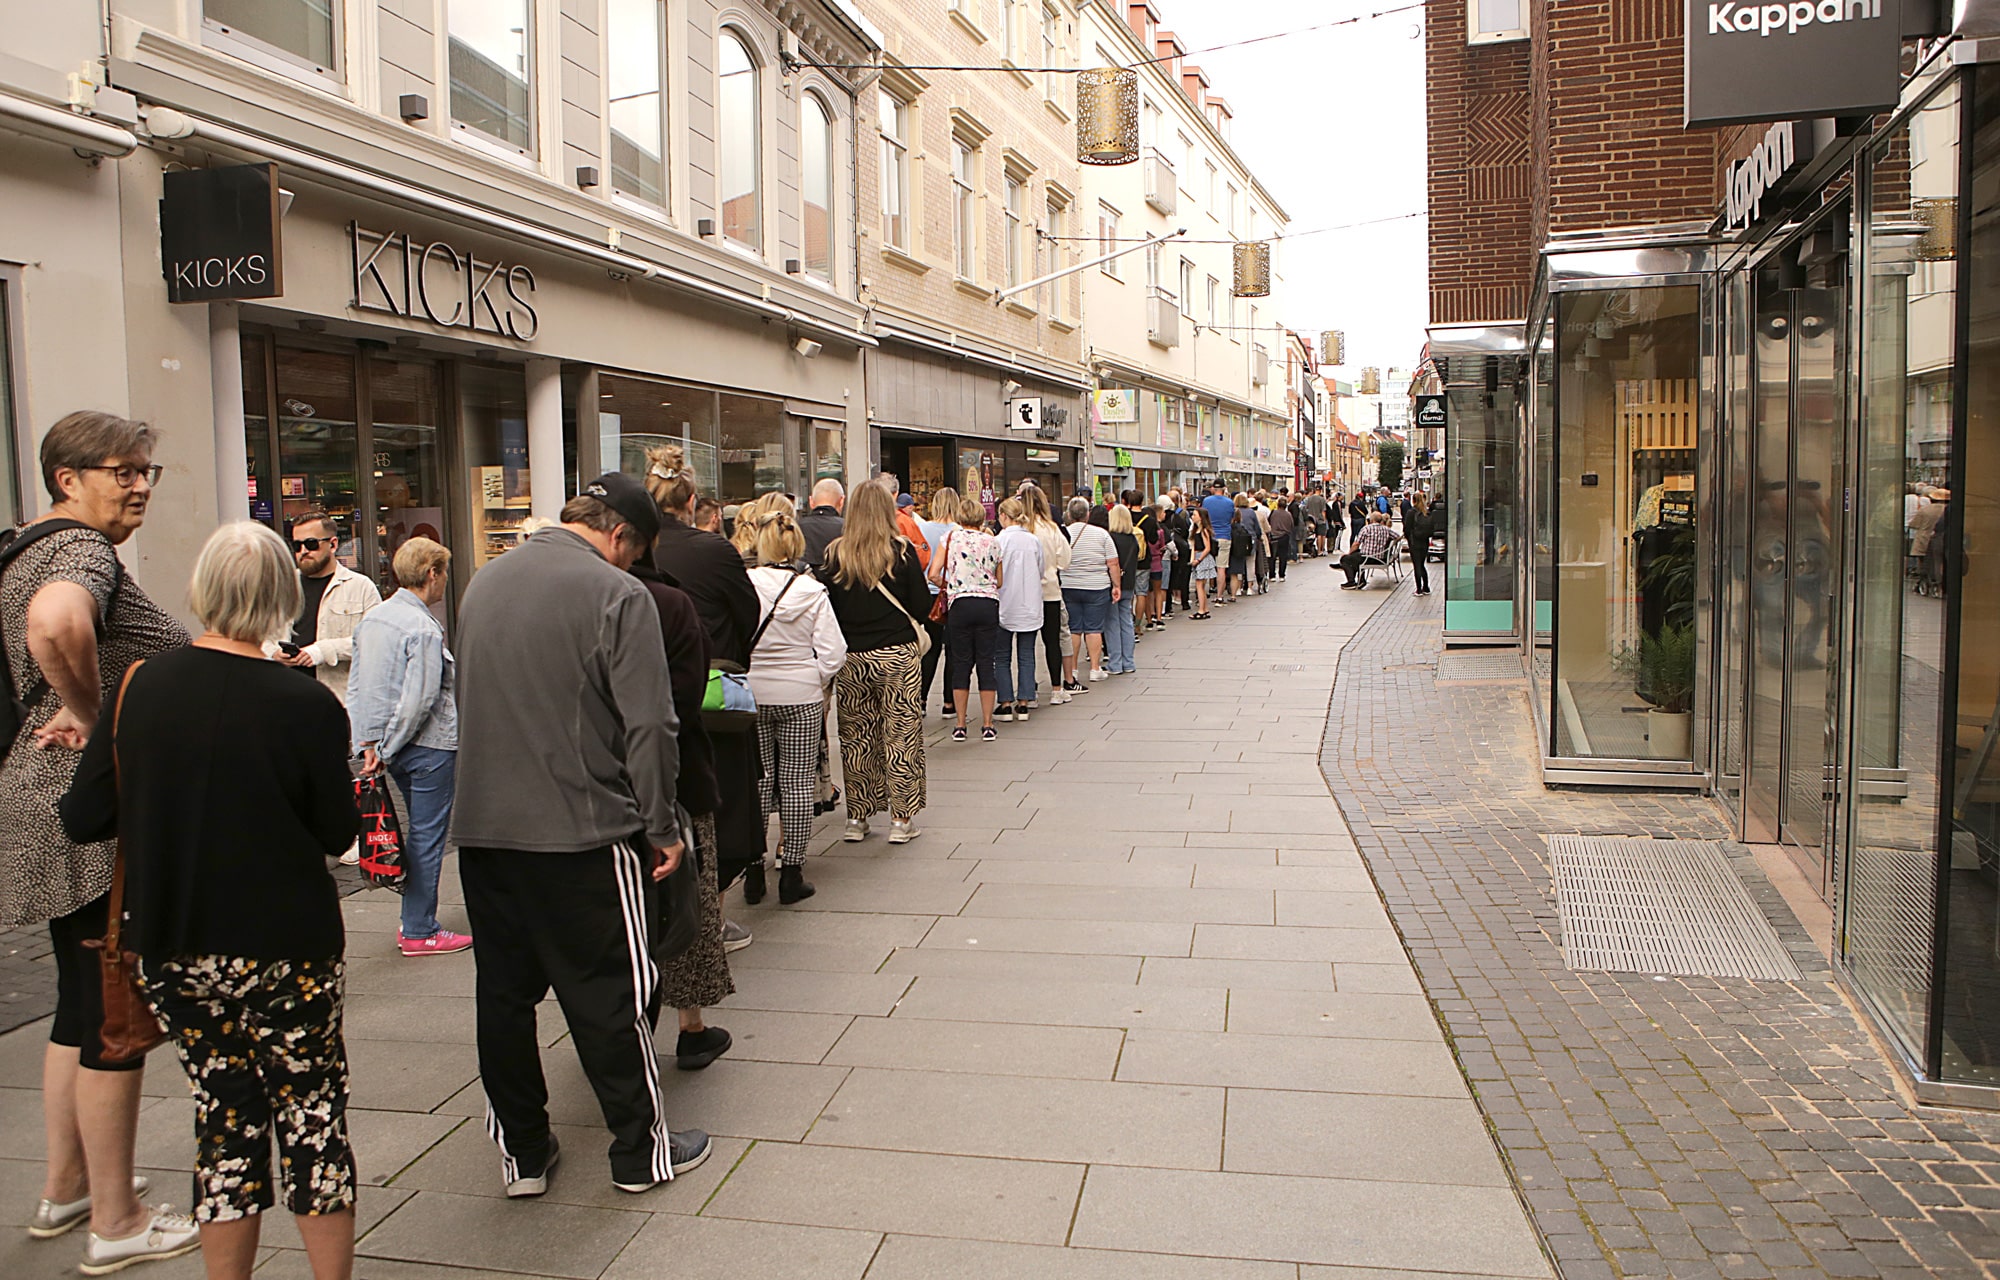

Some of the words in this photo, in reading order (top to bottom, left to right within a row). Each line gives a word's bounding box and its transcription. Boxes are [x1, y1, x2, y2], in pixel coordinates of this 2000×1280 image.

[175, 254, 266, 289] KICKS
[351, 219, 538, 342] KICKS
[981, 489, 994, 503] 50%
